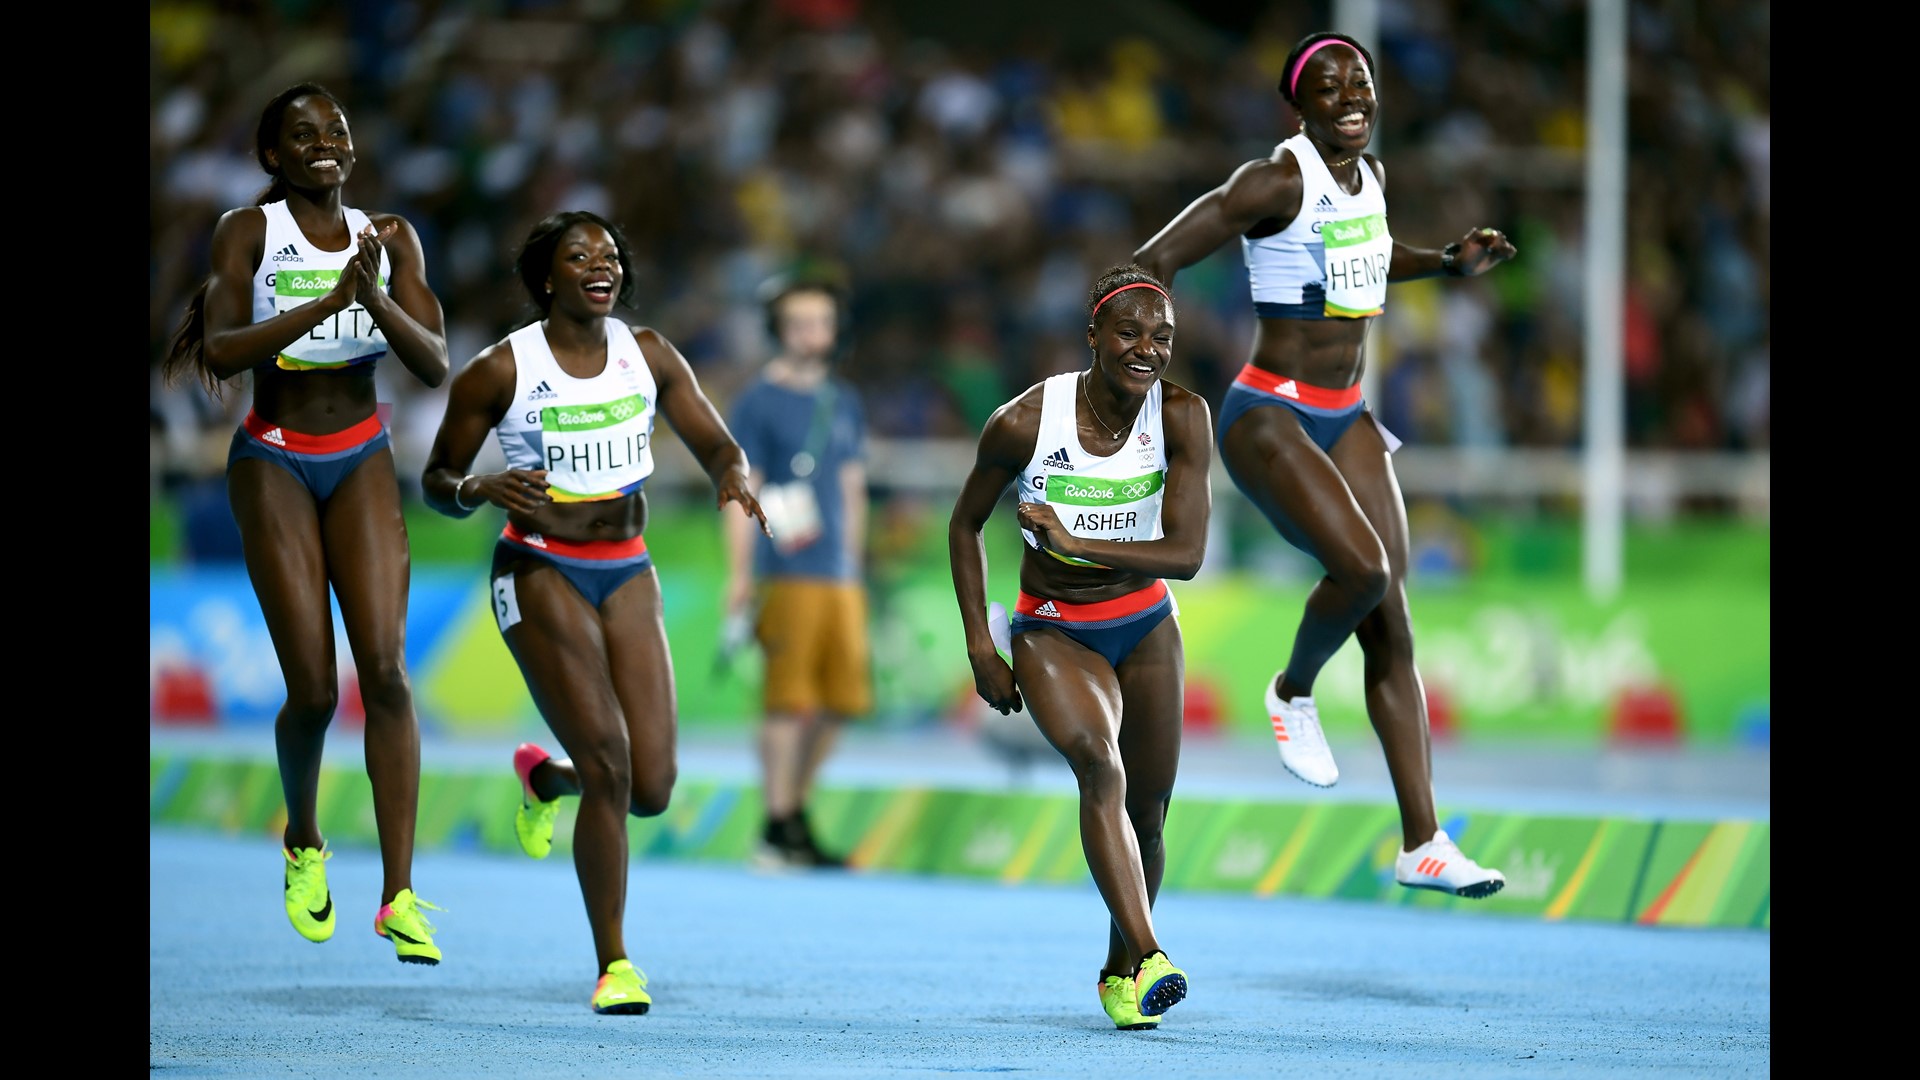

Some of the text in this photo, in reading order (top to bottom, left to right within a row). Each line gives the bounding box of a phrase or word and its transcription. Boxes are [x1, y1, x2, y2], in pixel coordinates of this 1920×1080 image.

[272, 254, 304, 263] adidas
[558, 410, 606, 425] Rio2016
[547, 432, 647, 472] PHILIP
[1042, 459, 1075, 472] adidas
[1064, 484, 1115, 499] Rio2016
[1073, 511, 1137, 531] ASHER
